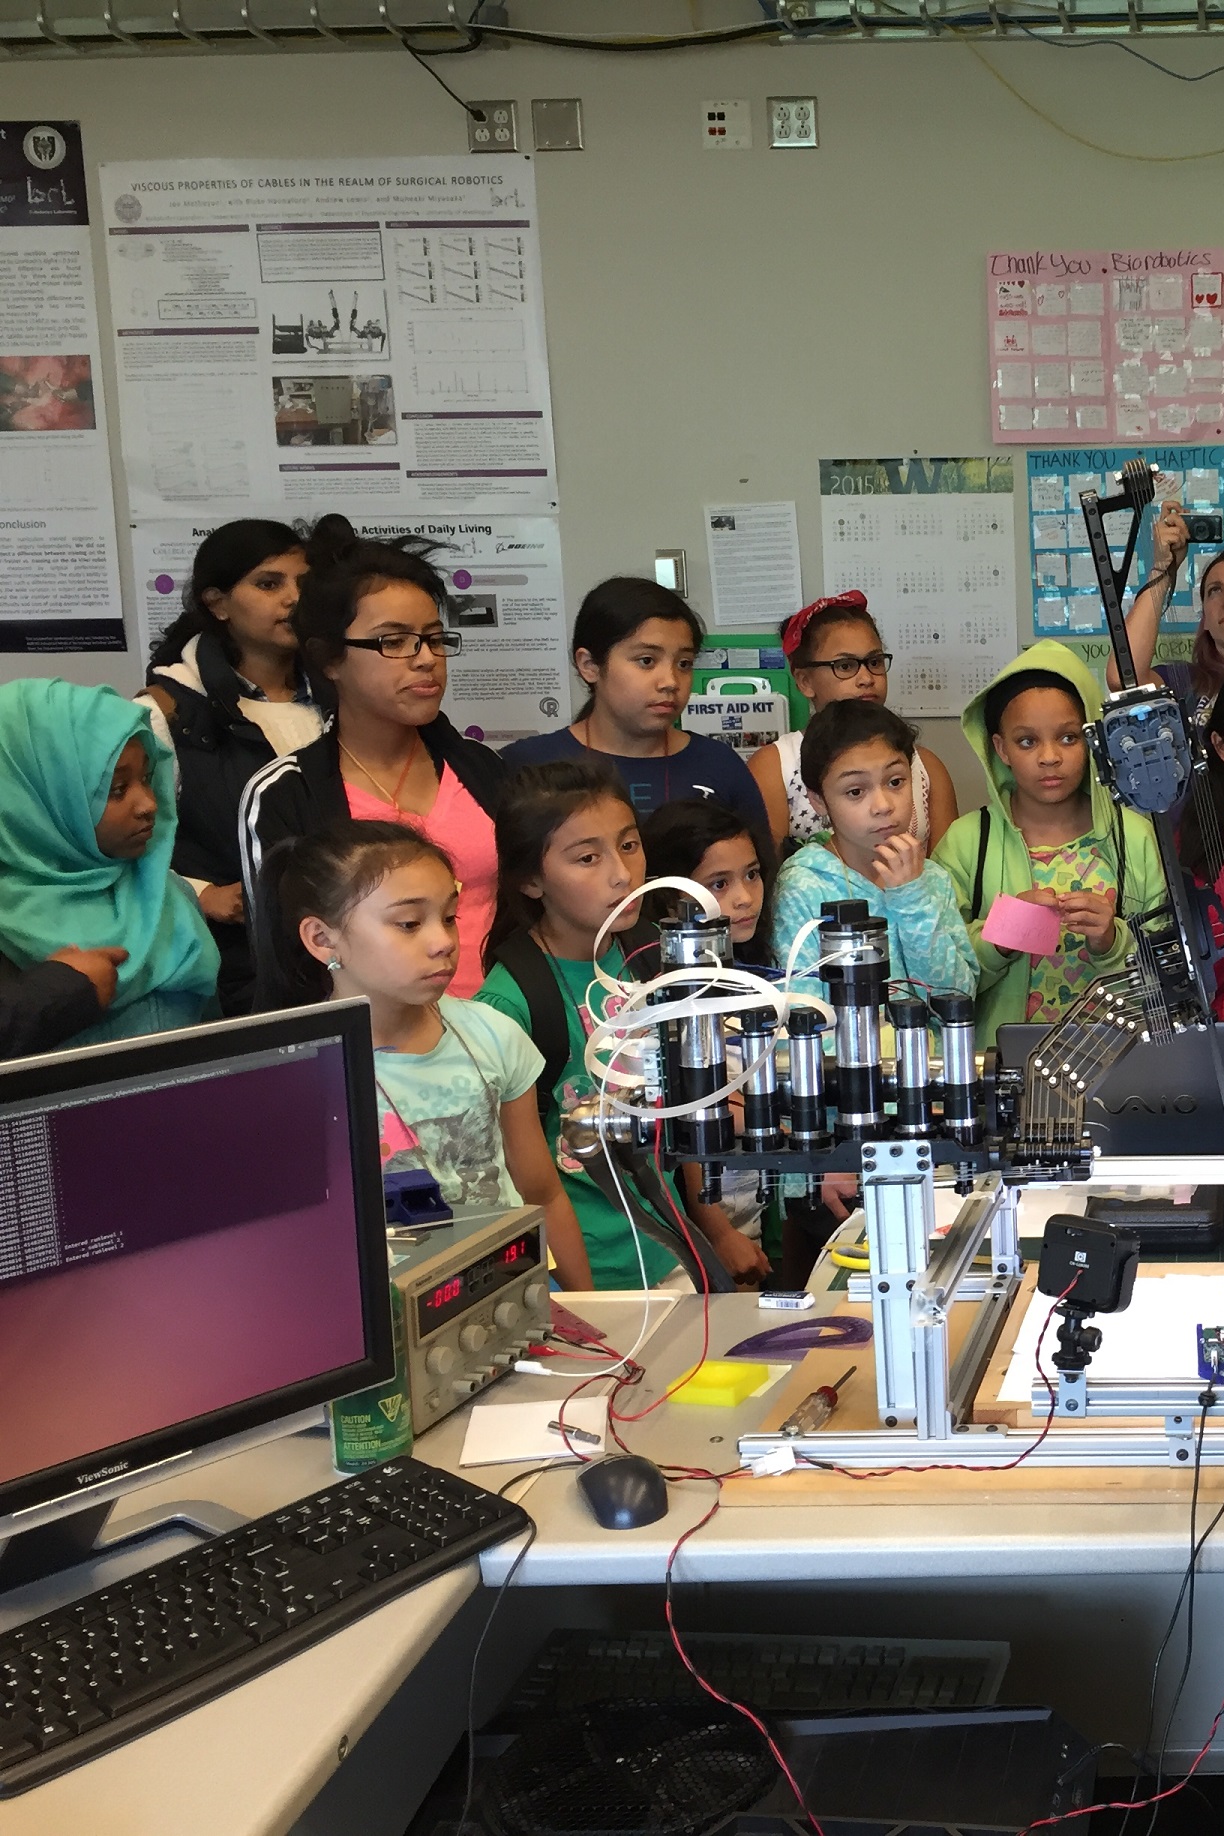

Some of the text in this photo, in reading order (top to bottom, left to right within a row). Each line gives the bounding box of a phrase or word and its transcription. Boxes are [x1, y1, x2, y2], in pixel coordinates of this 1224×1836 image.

[131, 175, 503, 192] VISCOUS PROPERTIES OF CABLES IN THE REALM OF SURGICAL ROBOTICS
[990, 251, 1212, 278] Thank You Biorobotics
[1030, 452, 1080, 469] THANK
[1084, 450, 1116, 469] YOU
[830, 476, 875, 495] 2015
[361, 524, 411, 534] Activities
[414, 524, 425, 534] of
[428, 524, 455, 536] Daily
[459, 524, 493, 535] Living
[1082, 643, 1111, 662] YOU
[687, 702, 774, 715] FIRST AID KIT
[1093, 1095, 1198, 1114] VAIO
[340, 1414, 371, 1424] CAUTION
[343, 1440, 381, 1451] ATTENTION
[77, 1461, 129, 1484] ViewSonic
